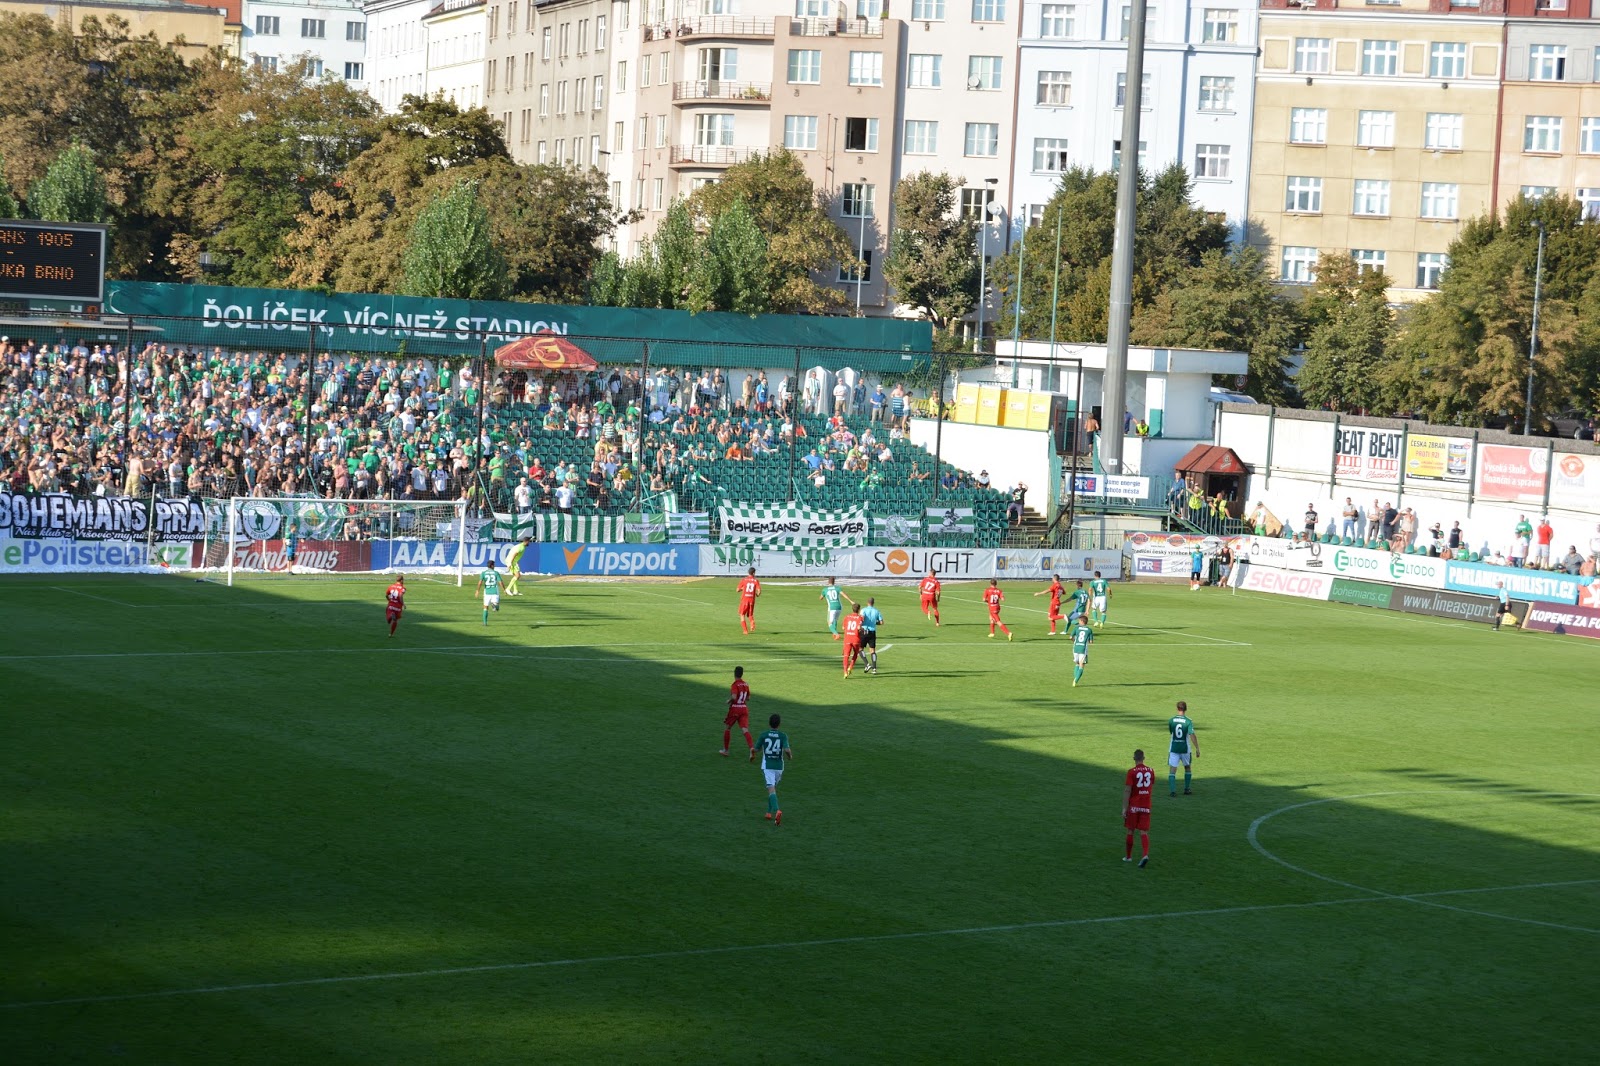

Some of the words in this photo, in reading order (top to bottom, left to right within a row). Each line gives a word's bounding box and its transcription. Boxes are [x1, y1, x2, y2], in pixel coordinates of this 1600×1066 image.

[36, 232, 74, 247] 1905
[35, 265, 74, 280] BRNO
[203, 299, 333, 337] ĎOLÍČEK,
[344, 306, 388, 335] VÍC
[395, 310, 448, 338] NEŽ
[455, 317, 568, 342] STADION
[1369, 431, 1402, 459] BEAT
[1337, 455, 1361, 467] ADIO
[1484, 462, 1507, 473] Vysoká
[1509, 463, 1526, 474] škola
[1483, 474, 1511, 485] finanční
[1517, 477, 1543, 488] správní
[0, 493, 147, 532] BOHEMIANS
[15, 527, 36, 536] Náš
[39, 528, 62, 537] klub
[75, 529, 111, 538] Vršovic
[727, 519, 801, 534] BOHEMIANS
[808, 522, 864, 535] FOREVER
[250, 531, 270, 540] PRAHA
[224, 541, 339, 569] Gambinus
[393, 543, 446, 565] AAA
[587, 547, 678, 575] Tipsport
[874, 550, 975, 574] SOLIGHT
[1334, 550, 1379, 571] ELTODO
[1139, 559, 1160, 572] PRE
[485, 575, 496, 586] 23
[746, 582, 755, 592] 13
[1096, 582, 1103, 593] 4
[1248, 570, 1323, 595] SENCOR
[1449, 566, 1577, 599] PARLAMENTNILISTY.CZ
[827, 590, 838, 600] 10
[1332, 584, 1388, 602] bohemians.cz
[1403, 593, 1498, 618] www.lineasport.
[847, 620, 857, 631] 10
[1530, 609, 1573, 626] KOPEME
[1573, 615, 1587, 628] ZA
[1078, 630, 1086, 642] 8
[1175, 723, 1183, 739] 6
[764, 738, 781, 755] 24
[1136, 771, 1151, 788] 23
